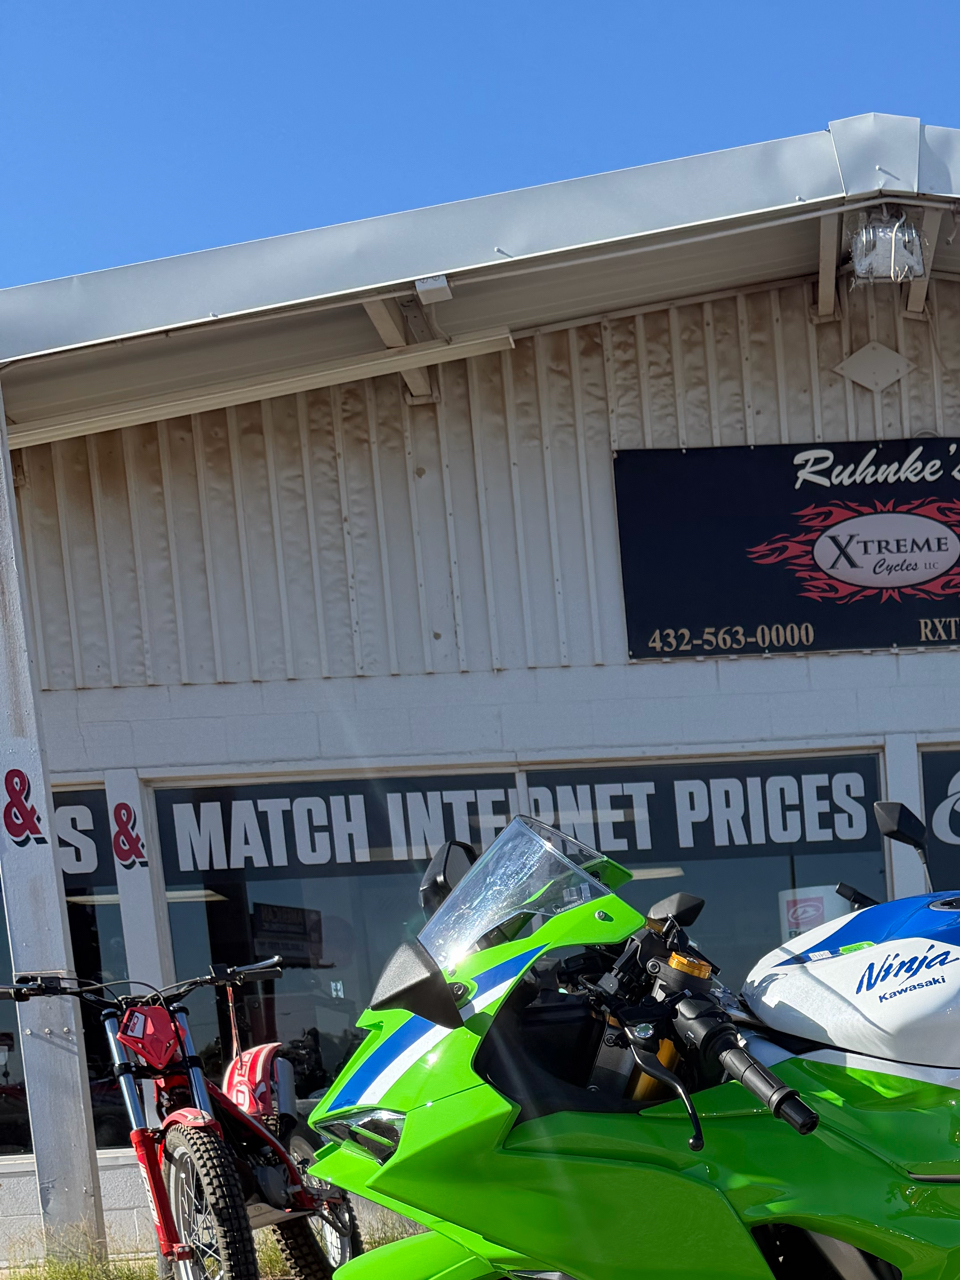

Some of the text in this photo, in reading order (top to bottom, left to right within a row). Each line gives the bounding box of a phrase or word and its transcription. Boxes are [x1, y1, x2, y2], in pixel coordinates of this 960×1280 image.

[825, 532, 949, 570] XTREME
[872, 557, 939, 576] Cycles LLC
[648, 622, 815, 652] 432-563-0000
[172, 793, 371, 872] MATCH
[386, 781, 656, 861] INTERNET
[673, 771, 867, 849] PRICES
[856, 944, 960, 995] Ninja
[879, 975, 946, 1003] Kawasaki
